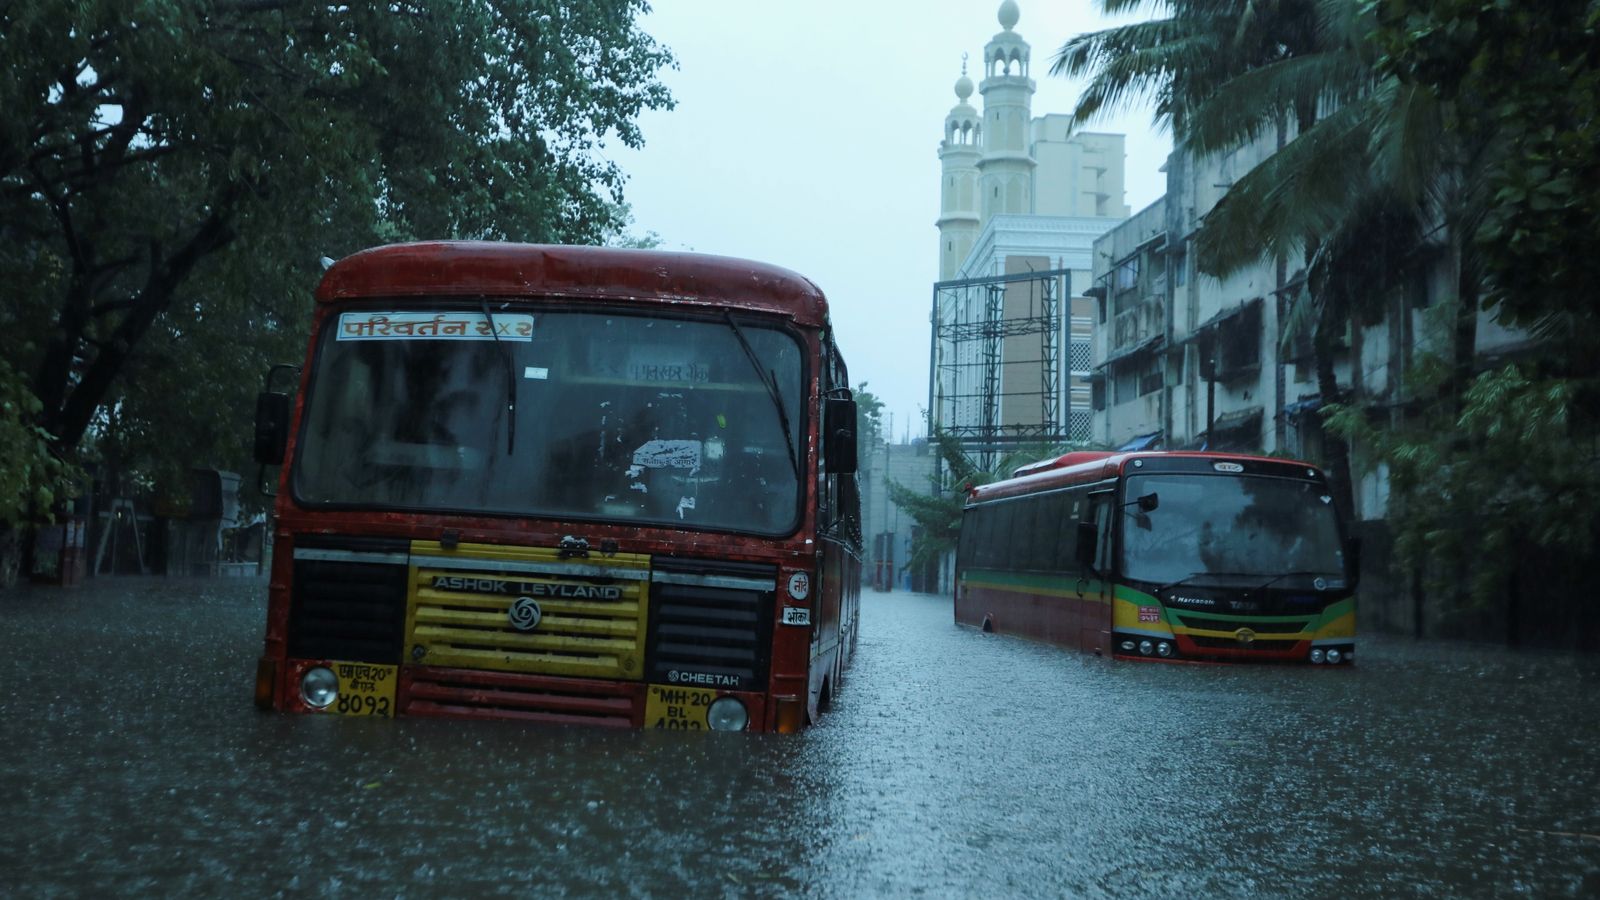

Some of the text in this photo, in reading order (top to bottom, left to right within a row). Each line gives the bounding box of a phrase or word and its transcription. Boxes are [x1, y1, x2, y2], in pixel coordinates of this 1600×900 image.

[344, 315, 470, 336] परिवर्तन
[434, 577, 621, 599] ASHOK LEYLAND
[680, 671, 739, 687] CHEETAH
